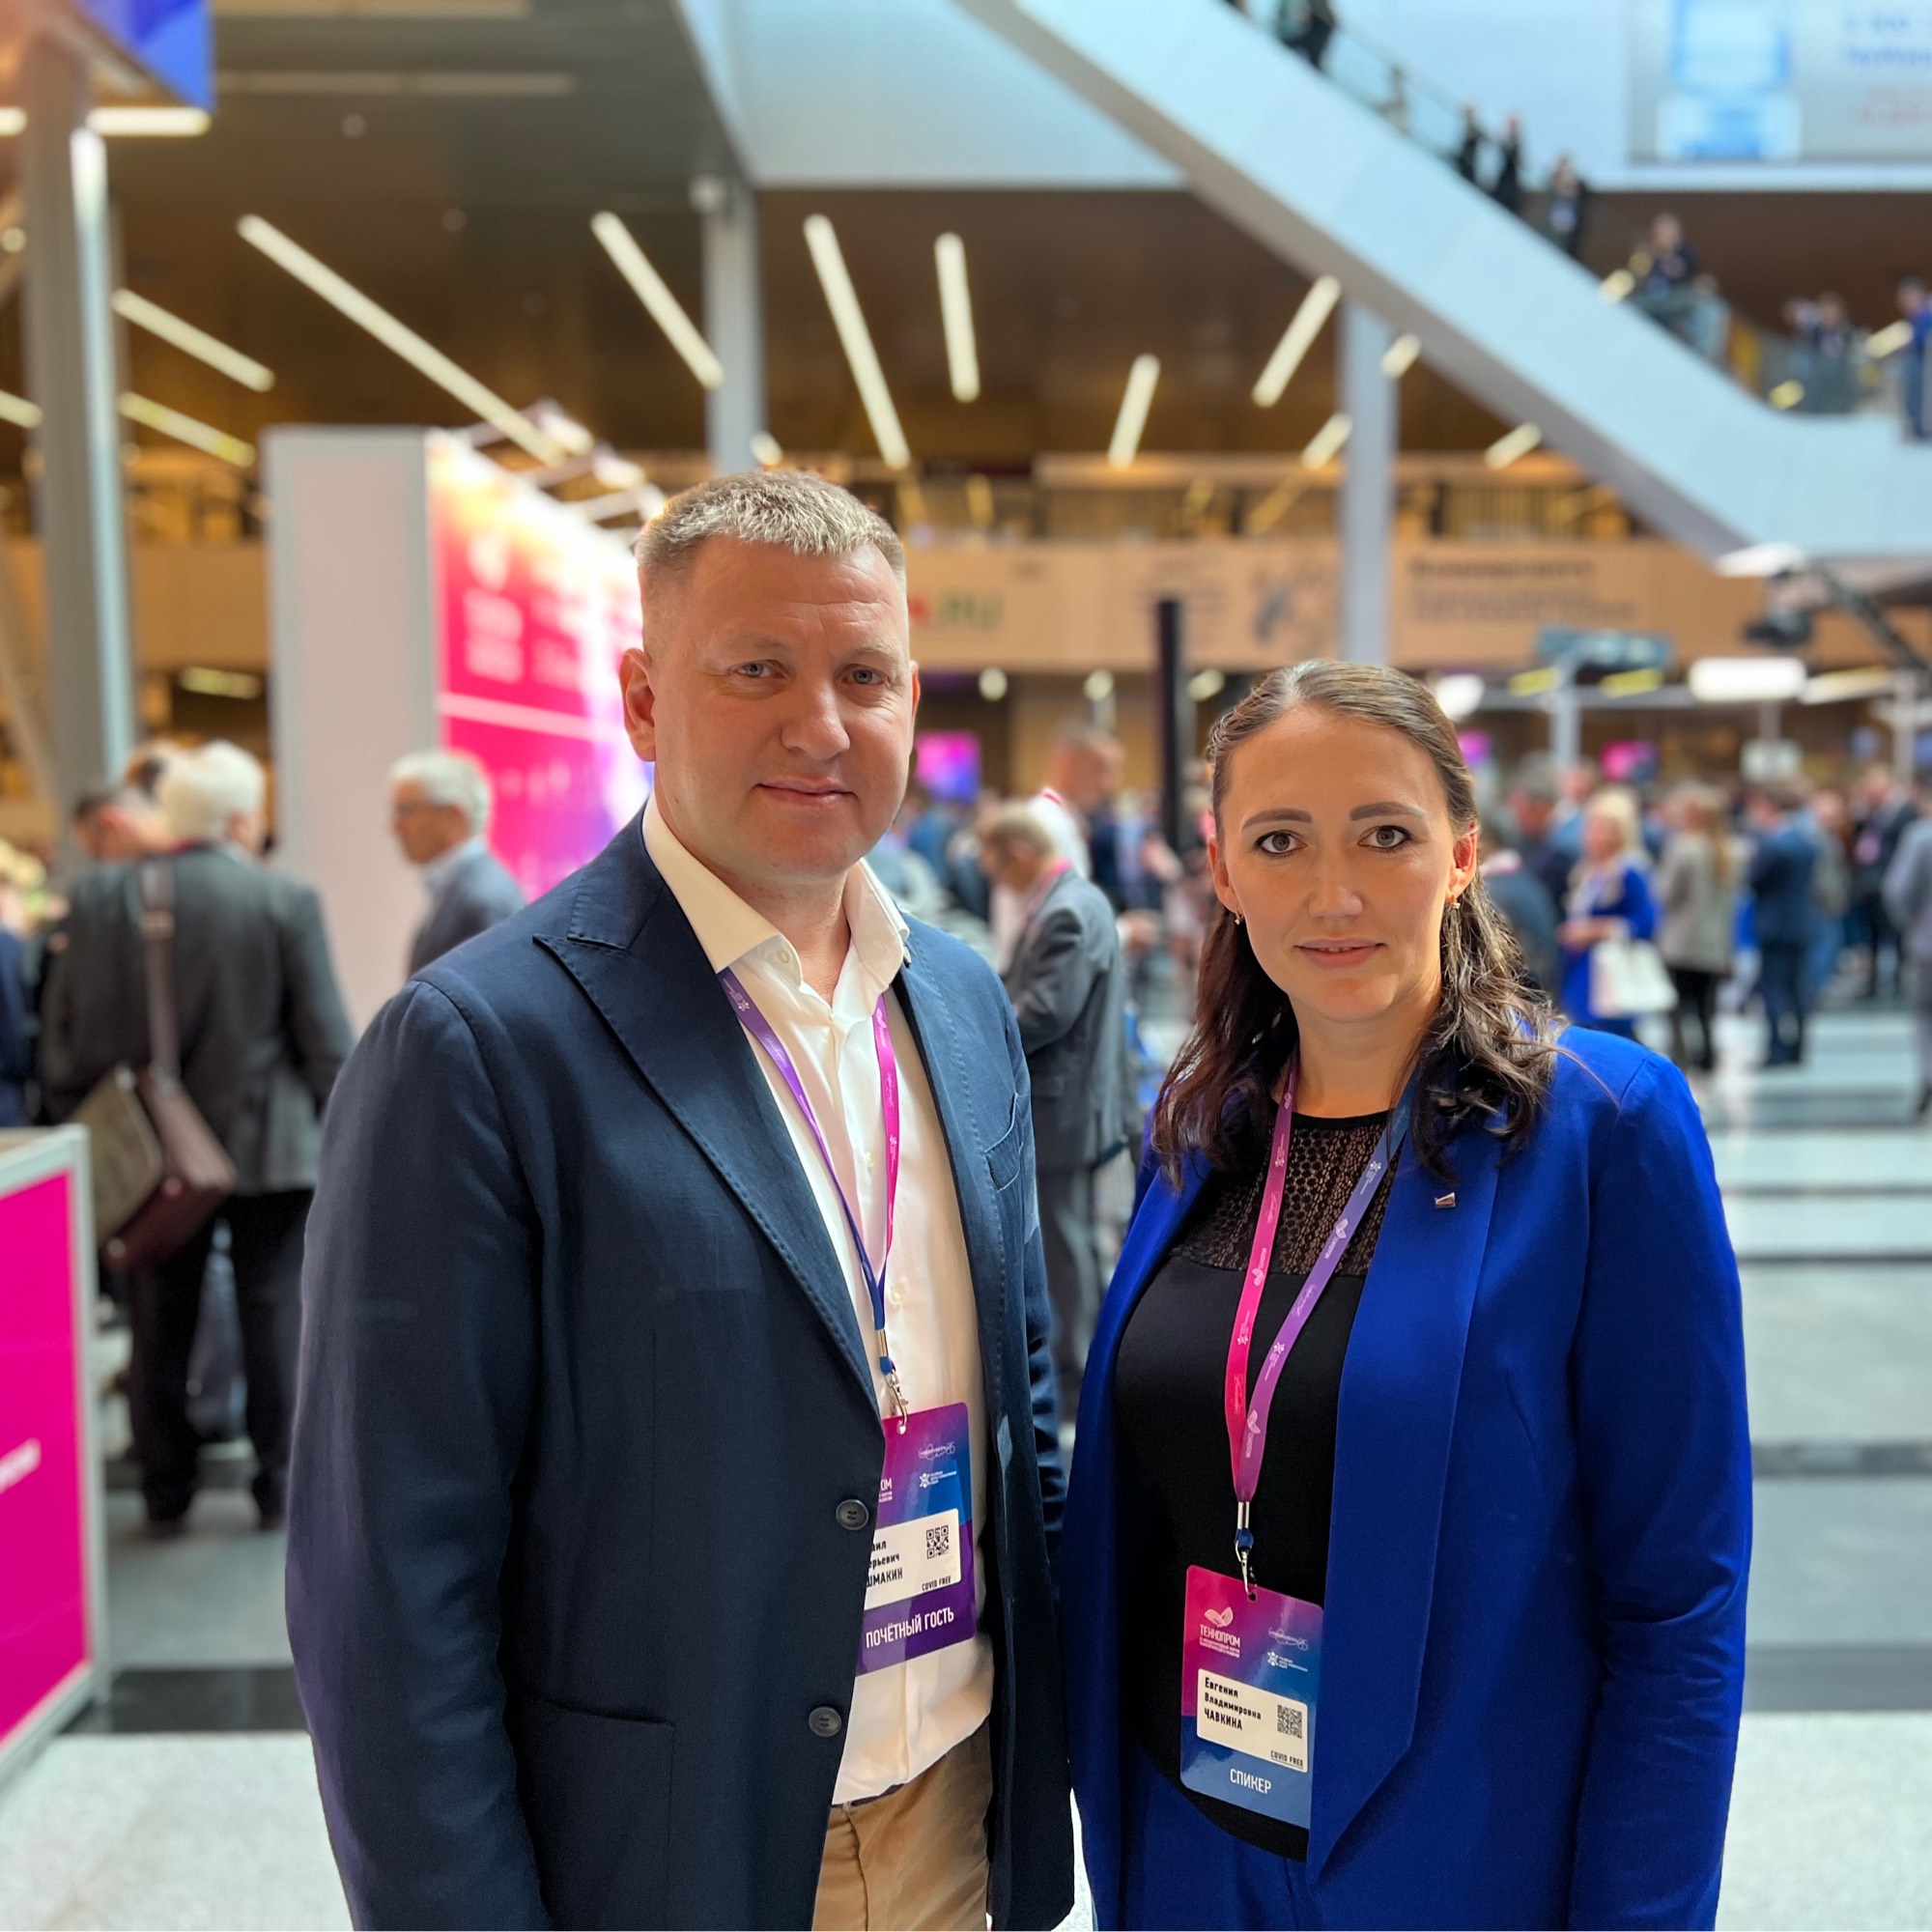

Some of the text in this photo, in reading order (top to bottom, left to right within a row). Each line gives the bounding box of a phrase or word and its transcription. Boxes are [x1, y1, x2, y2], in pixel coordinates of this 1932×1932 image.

[922, 1576, 952, 1591] COVID FREE
[866, 1606, 954, 1648] ПОЧЁТНЫЙ ГОСТЬ
[1205, 1676, 1238, 1698] Евгения
[1205, 1691, 1262, 1719] Владимировна
[1204, 1707, 1243, 1730] ЧАВКИНА
[1230, 1768, 1272, 1794] СПИКЕР
